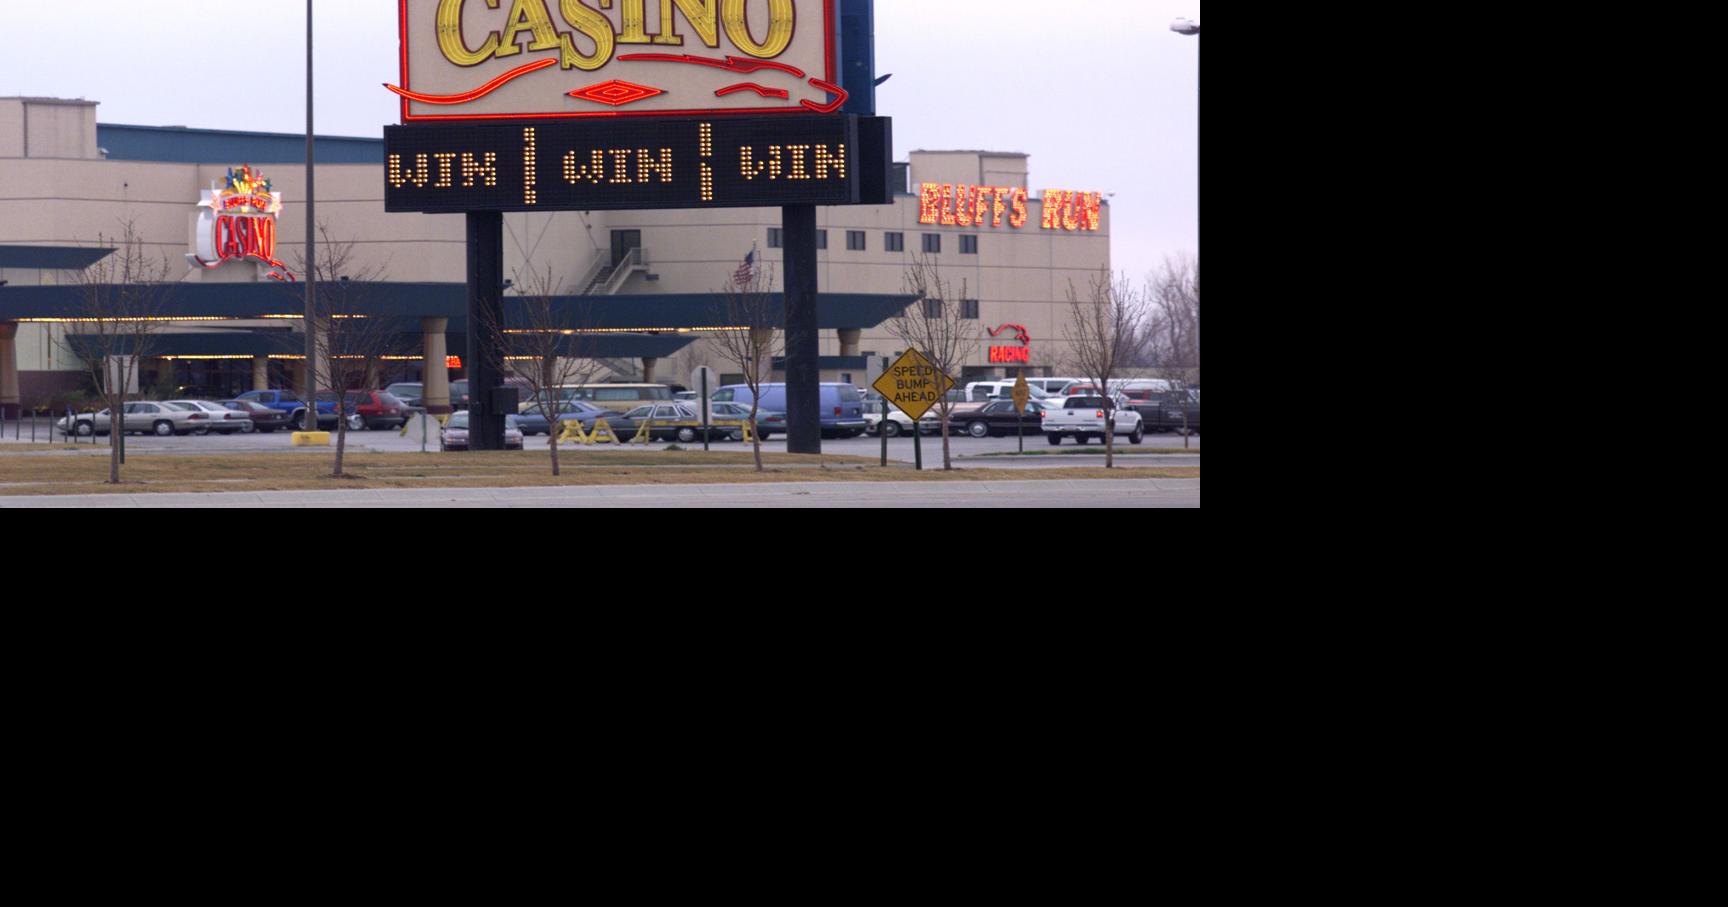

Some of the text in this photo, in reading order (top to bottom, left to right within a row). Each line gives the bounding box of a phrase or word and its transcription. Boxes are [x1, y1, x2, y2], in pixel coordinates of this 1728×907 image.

[435, 0, 797, 71] CASINO
[388, 143, 846, 187] WIN WIN WIN
[1041, 189, 1102, 231] RUN
[216, 215, 274, 260] CASINO
[989, 346, 1030, 364] RACING
[894, 366, 933, 377] SPEED
[896, 379, 930, 390] BUMP
[894, 391, 937, 403] AHEAD
